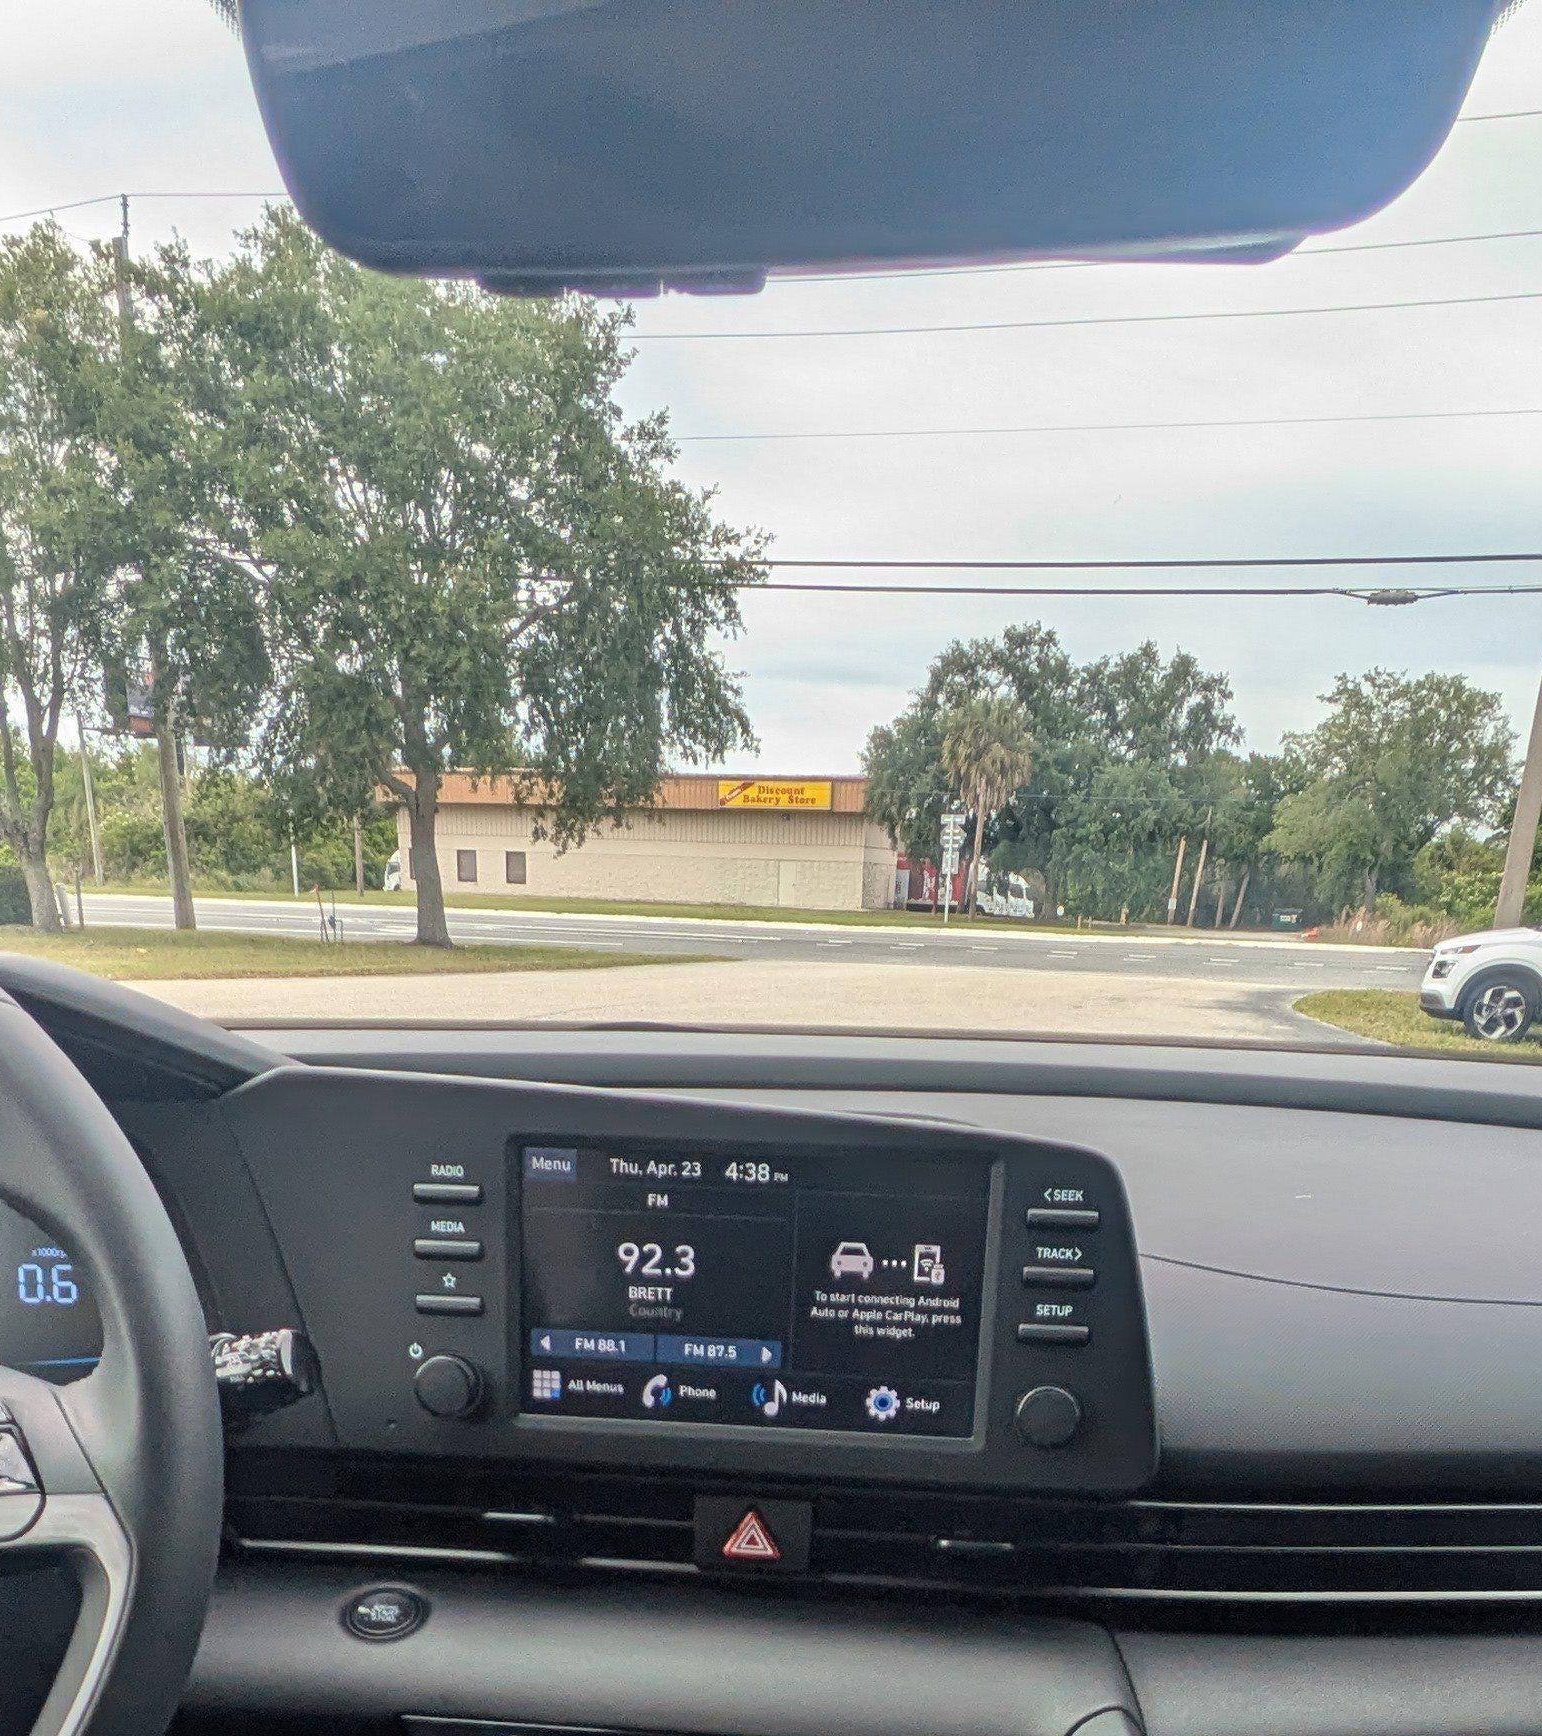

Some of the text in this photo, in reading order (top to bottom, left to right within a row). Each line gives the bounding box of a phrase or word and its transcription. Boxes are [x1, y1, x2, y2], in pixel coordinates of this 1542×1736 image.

[758, 785, 806, 796] Discount
[742, 794, 817, 806] Bakery Store
[430, 1164, 465, 1178] RADIO
[531, 1156, 571, 1172] Menu
[646, 1160, 678, 1179] Apr.
[681, 1161, 702, 1178] 23
[724, 1162, 789, 1182] 4:38 PM
[647, 1193, 669, 1208] FM
[430, 1220, 466, 1234] MEDIA
[617, 1242, 696, 1278] 92.3
[17, 1263, 79, 1304] 0.6
[628, 1286, 673, 1301] BRETT
[815, 1290, 960, 1309] To start connecting Android
[628, 1303, 683, 1321] Country
[810, 1307, 836, 1319] Auto
[838, 1309, 849, 1319] or
[852, 1308, 883, 1322] Apple
[931, 1314, 962, 1327] press
[1035, 1304, 1074, 1317] SETUP
[854, 1324, 916, 1340] this widget.
[574, 1337, 627, 1353] FM 88.1
[684, 1342, 738, 1359] FM 87.5
[568, 1379, 624, 1395] All Menus
[678, 1384, 717, 1400] Phone
[791, 1391, 827, 1405] Media
[905, 1396, 941, 1413] Setup
